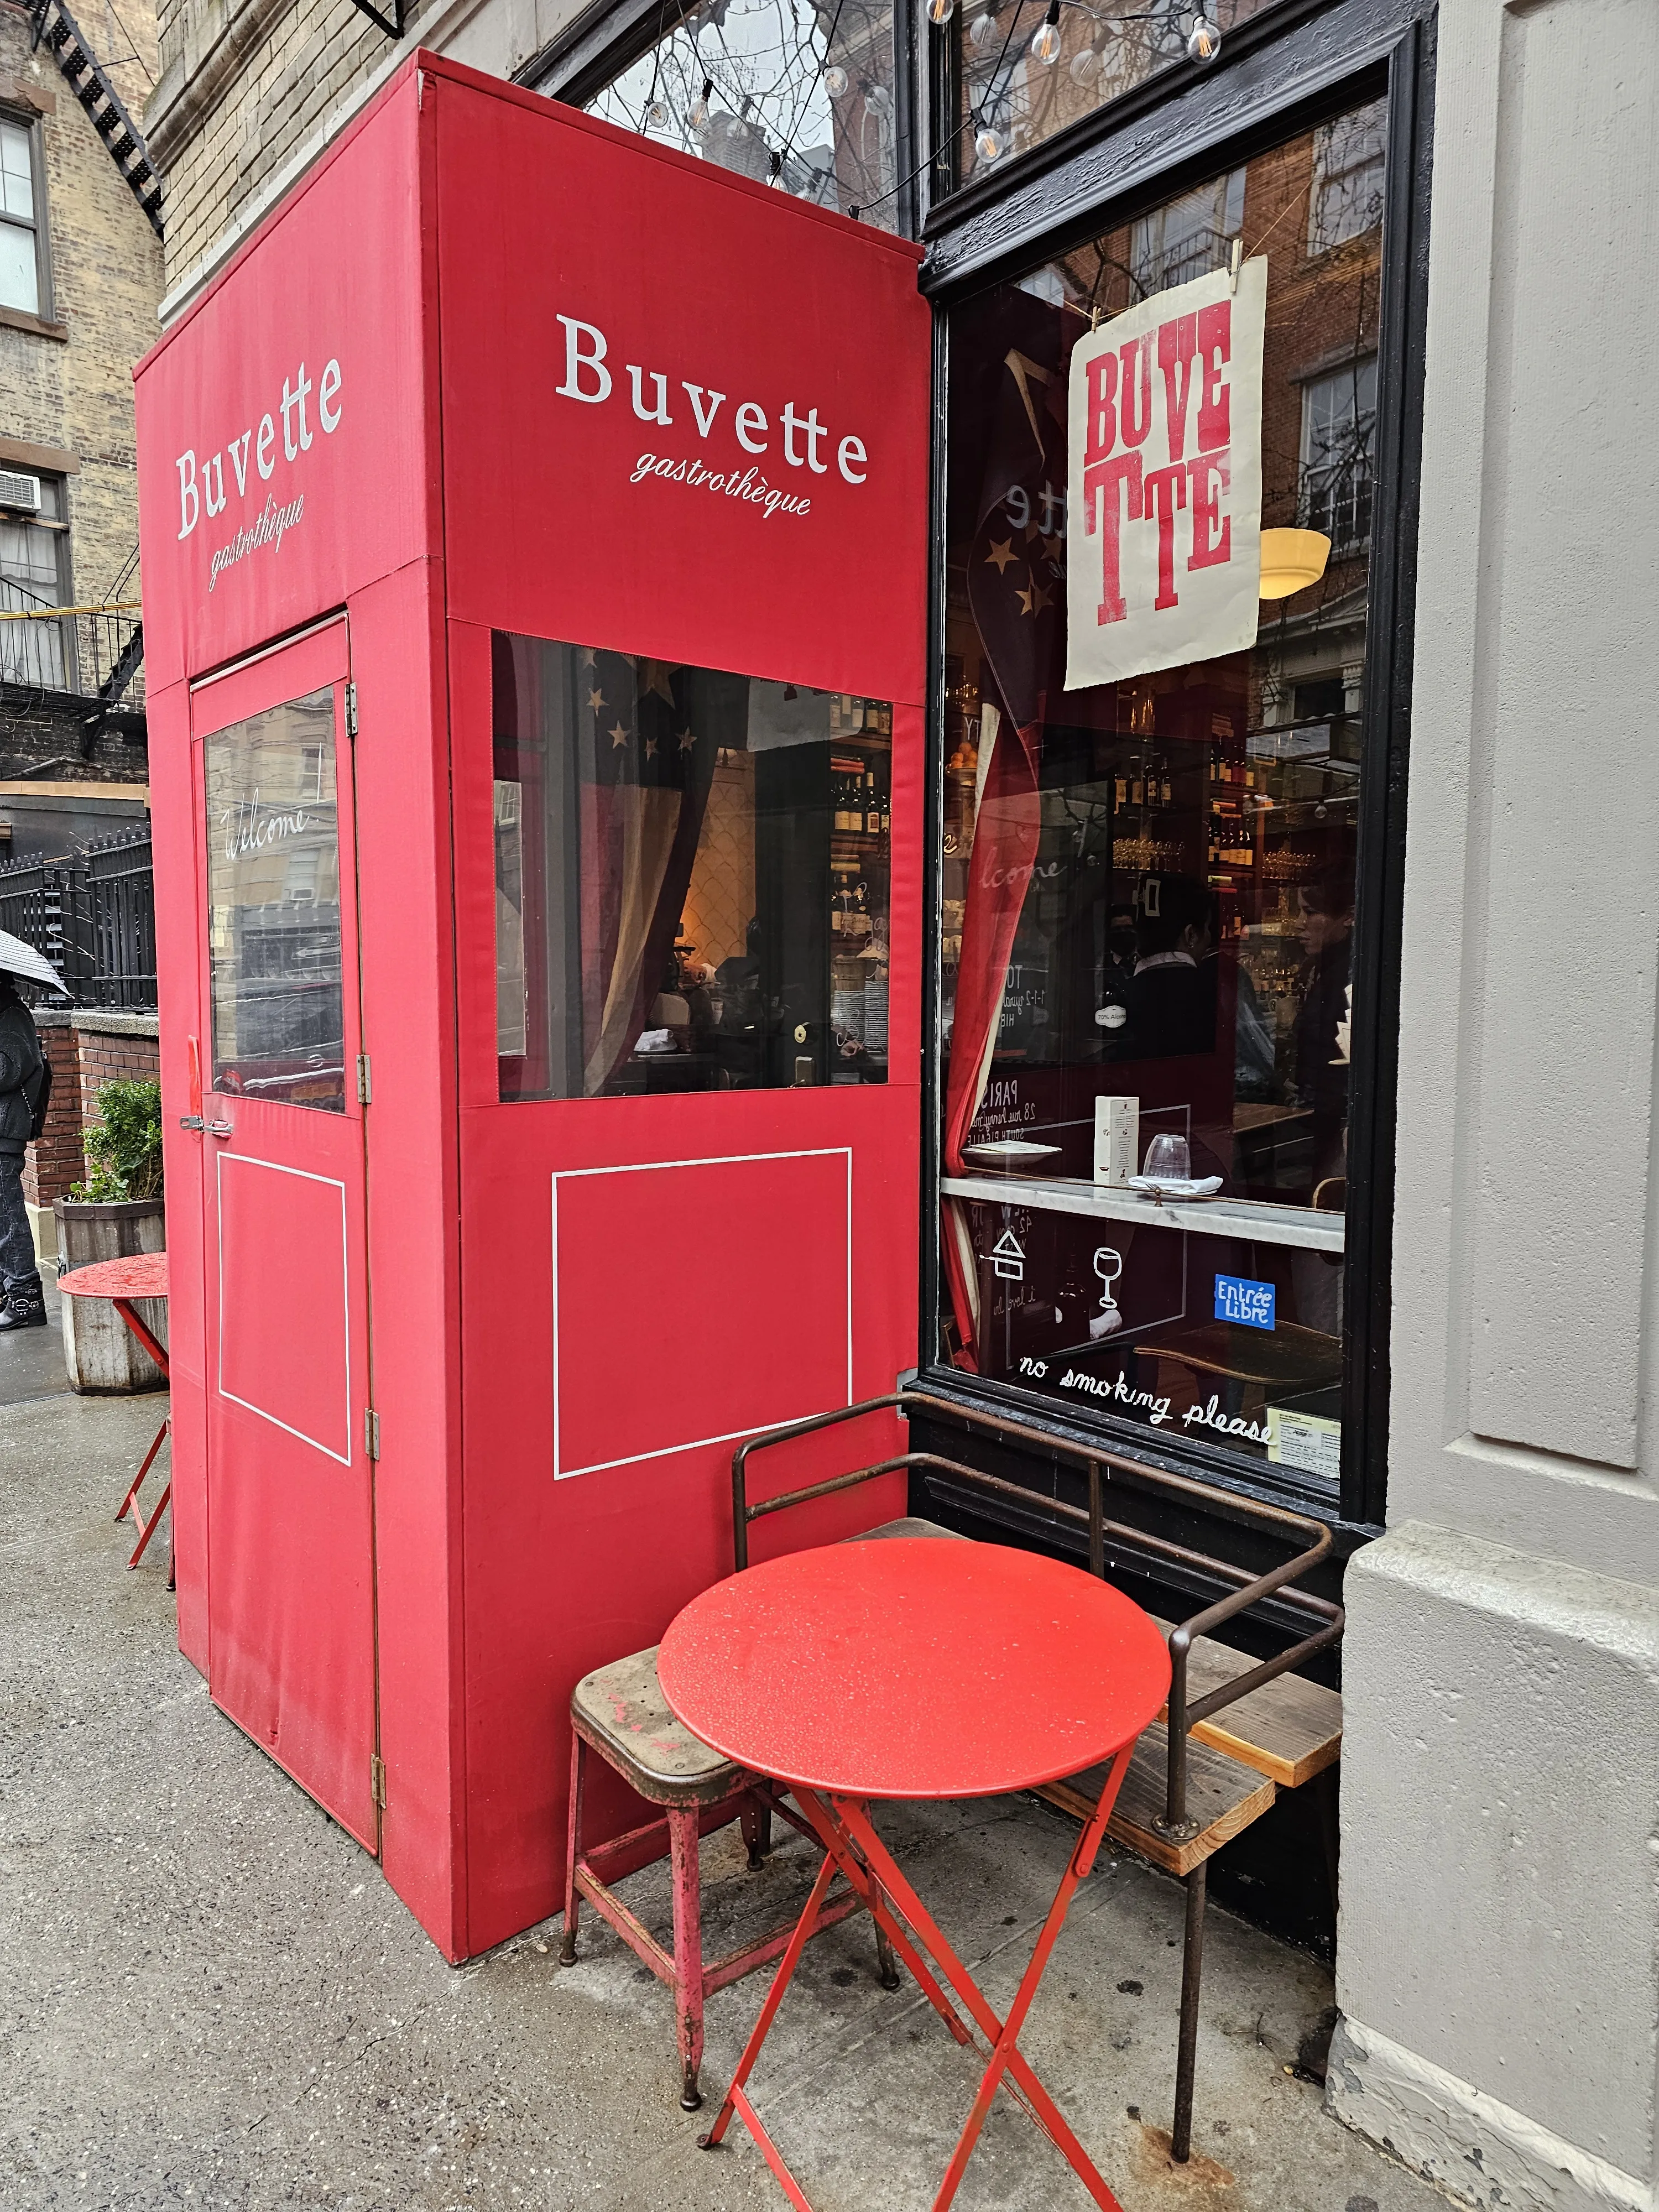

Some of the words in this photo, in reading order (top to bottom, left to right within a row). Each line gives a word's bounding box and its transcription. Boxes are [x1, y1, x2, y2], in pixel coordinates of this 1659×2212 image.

[555, 314, 868, 484] Buvette
[1084, 299, 1232, 467] BUVE
[176, 358, 342, 541] Buvette
[629, 453, 811, 518] gastrothèque
[209, 493, 304, 592] gastrothèque
[1084, 448, 1232, 626] TTE
[1218, 1281, 1272, 1308] Entrée
[1225, 1299, 1269, 1324] Libre
[1020, 1357, 1048, 1378] no
[1060, 1369, 1173, 1425] smoking
[1182, 1394, 1277, 1446] please
